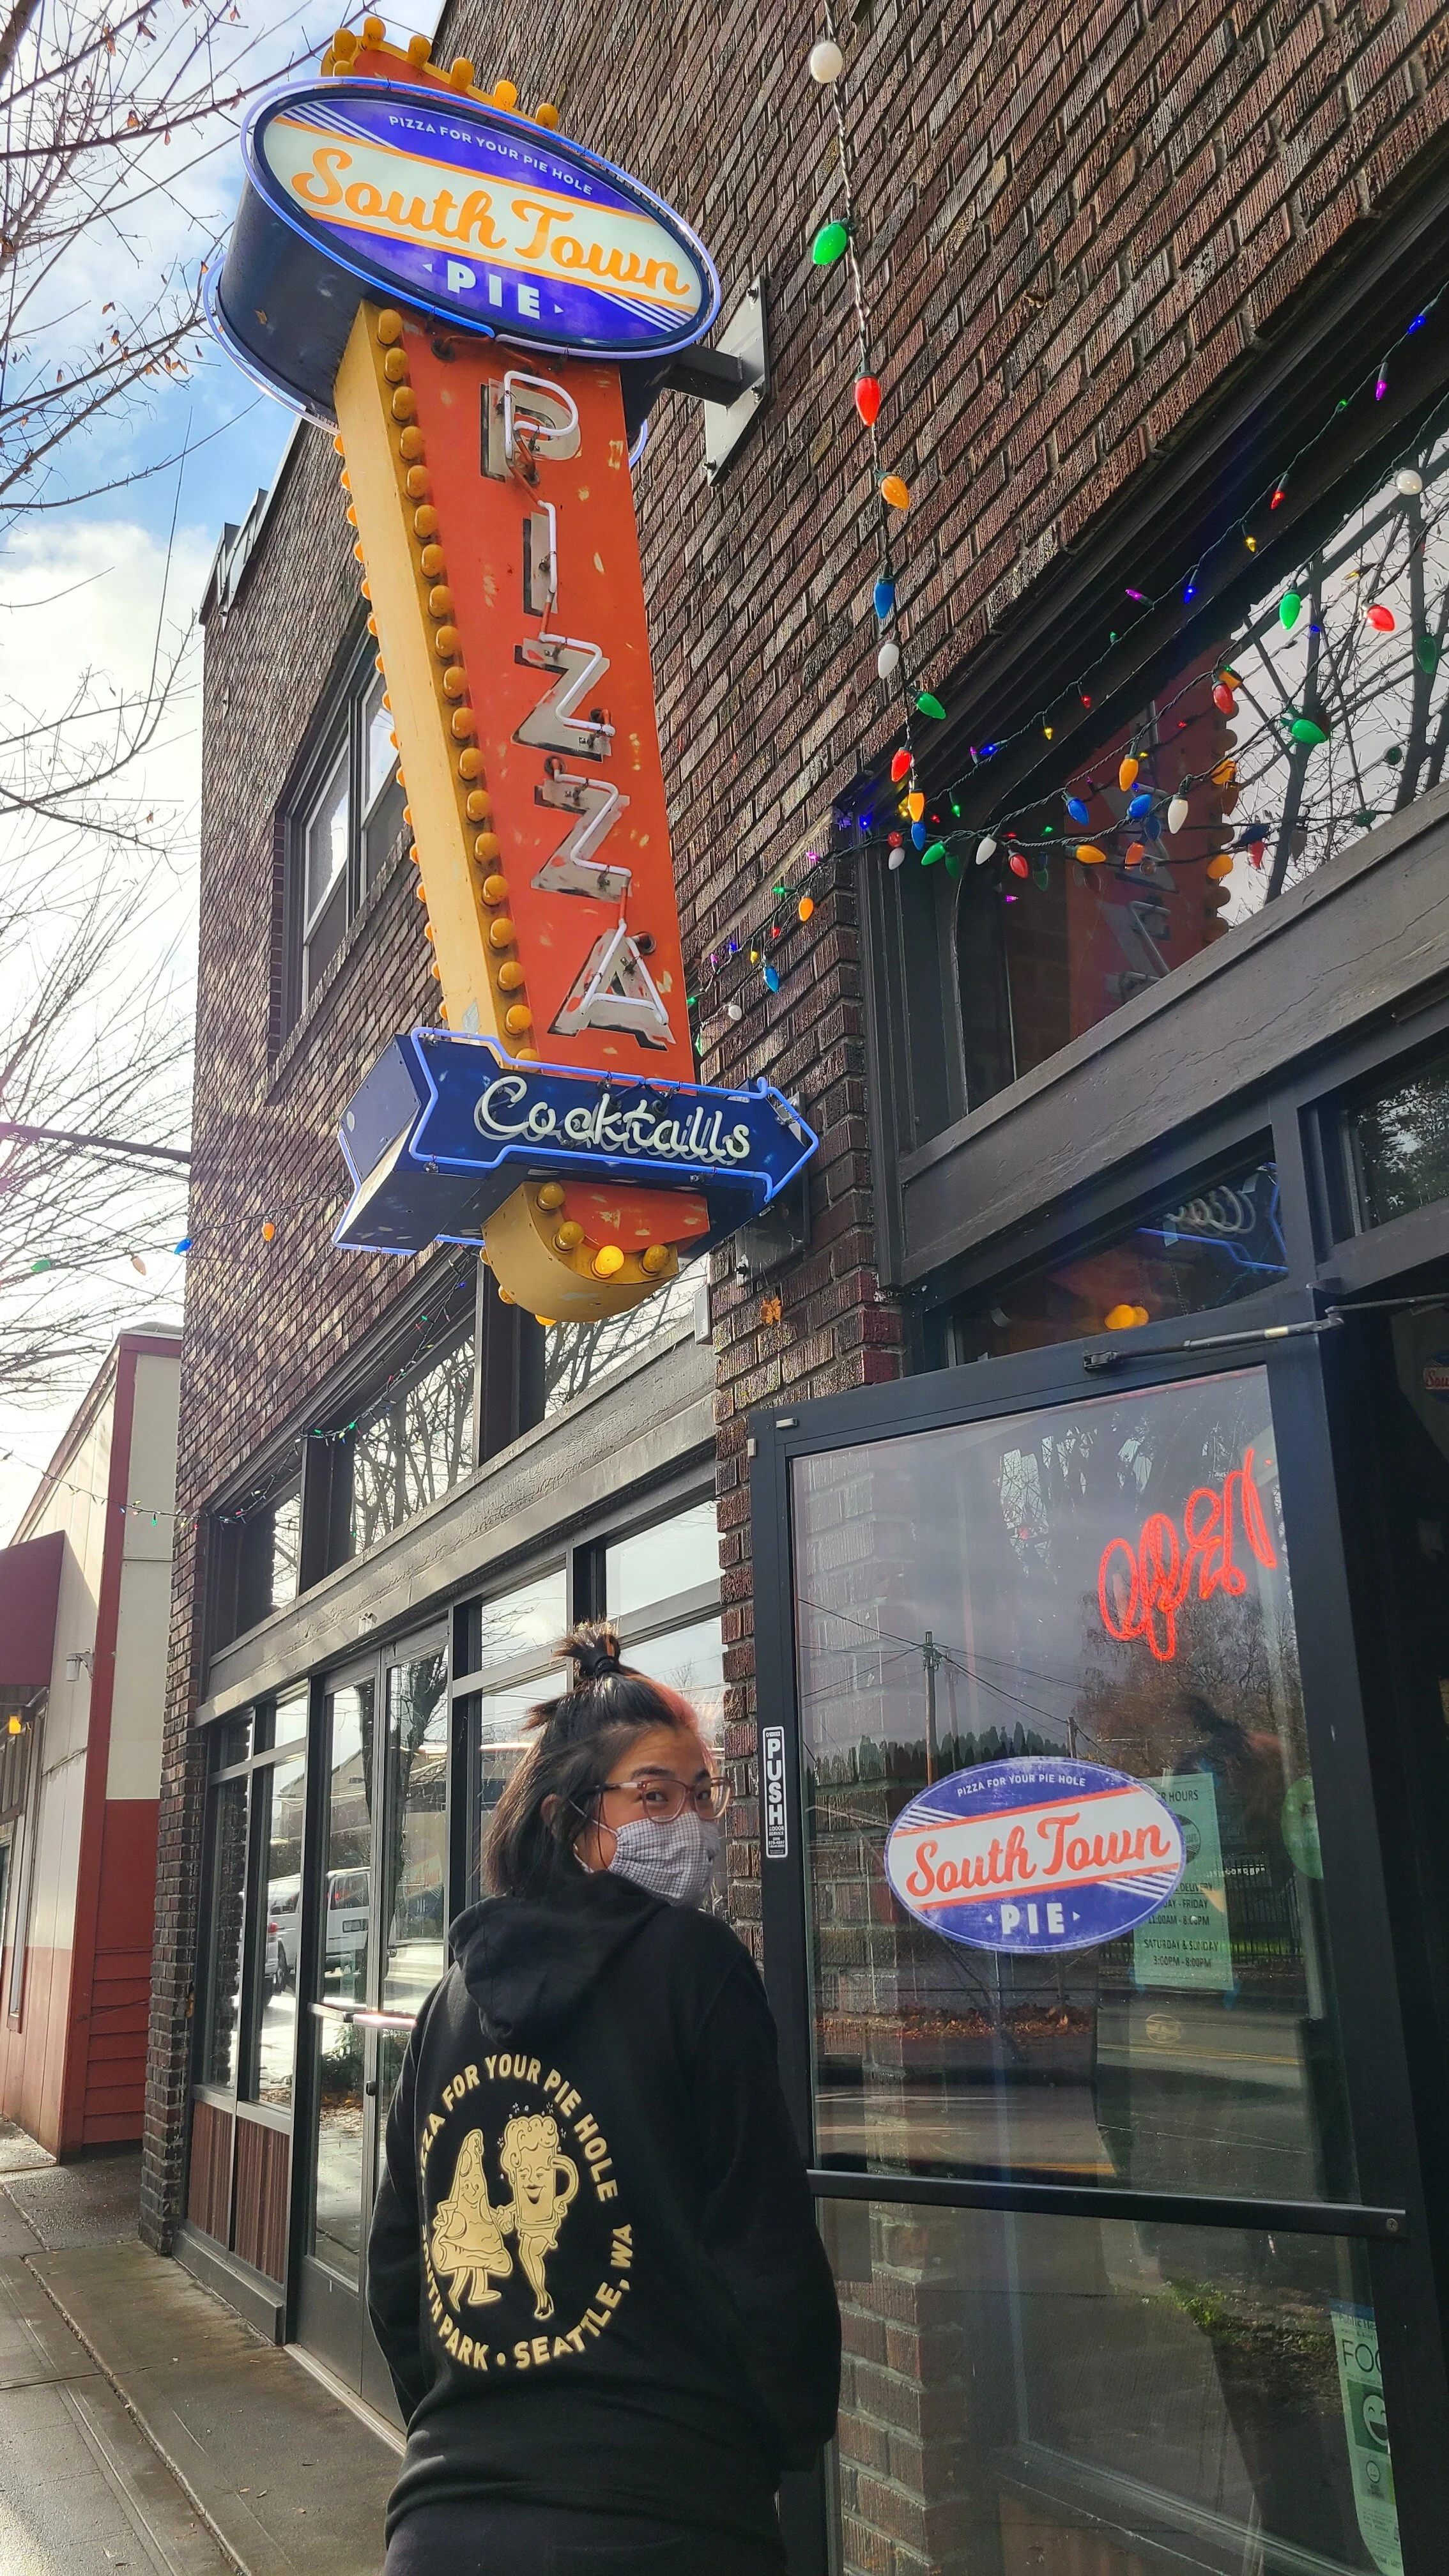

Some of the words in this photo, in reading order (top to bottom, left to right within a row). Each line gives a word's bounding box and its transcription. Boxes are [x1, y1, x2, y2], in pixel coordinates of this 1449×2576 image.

[388, 115, 436, 134] PIZZA
[440, 125, 473, 144] FOR
[475, 136, 519, 161] YOUR
[523, 154, 548, 173] PIE
[551, 167, 594, 195] HOLE
[291, 147, 508, 250] South
[510, 199, 691, 296] Town
[447, 259, 541, 321] PIE
[480, 371, 676, 1052] PIZZA
[767, 1738, 783, 1825] PUSH
[957, 1782, 985, 1797] PIZZA
[986, 1777, 1006, 1788] FOR
[1009, 1774, 1036, 1784] YOUR
[1039, 1774, 1055, 1783] PIE
[1059, 1775, 1086, 1787] HOLE
[1169, 1790, 1199, 1802] HOURS
[905, 1825, 1036, 1897] South
[1037, 1812, 1171, 1875] Town
[1000, 1902, 1065, 1935] PIE
[1144, 1939, 1180, 1949] SATURDAY
[1183, 1899, 1208, 1909] FRIDAY
[442, 2063, 480, 2112] FOR
[485, 2053, 541, 2084] YOUR
[543, 2069, 581, 2118] PIE
[574, 2113, 618, 2202] HOLE
[439, 2313, 489, 2371] PARK
[610, 2223, 633, 2267] WA
